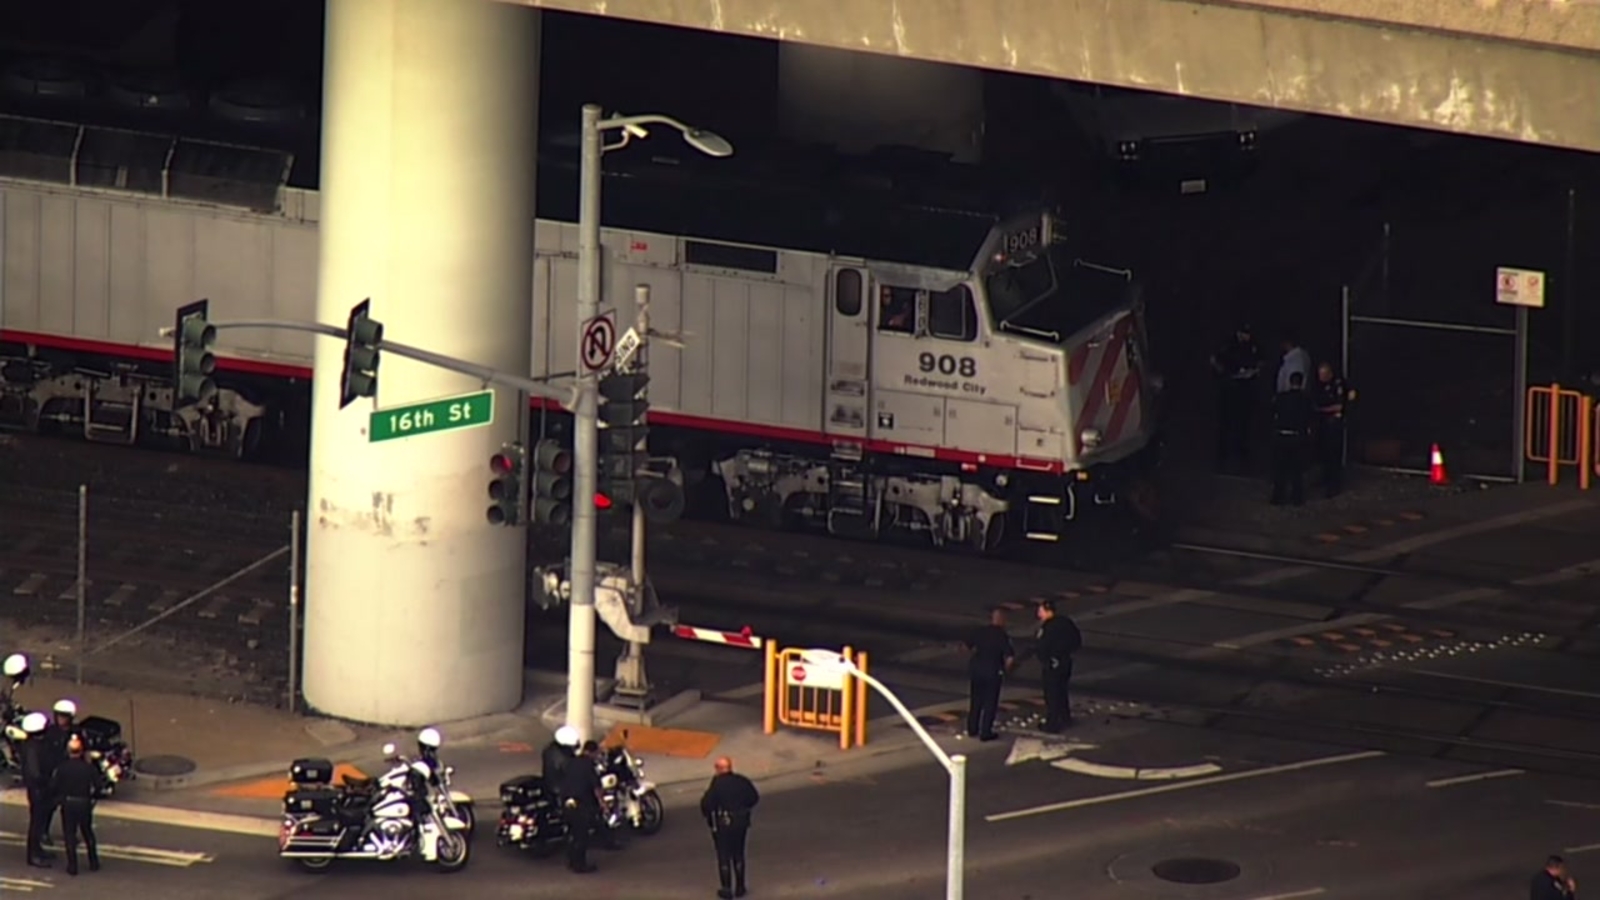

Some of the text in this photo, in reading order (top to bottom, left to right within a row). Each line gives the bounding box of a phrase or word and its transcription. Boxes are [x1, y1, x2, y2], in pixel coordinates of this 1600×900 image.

[919, 352, 976, 378] 908
[904, 374, 986, 396] Redwood City
[390, 402, 471, 433] 16th St
